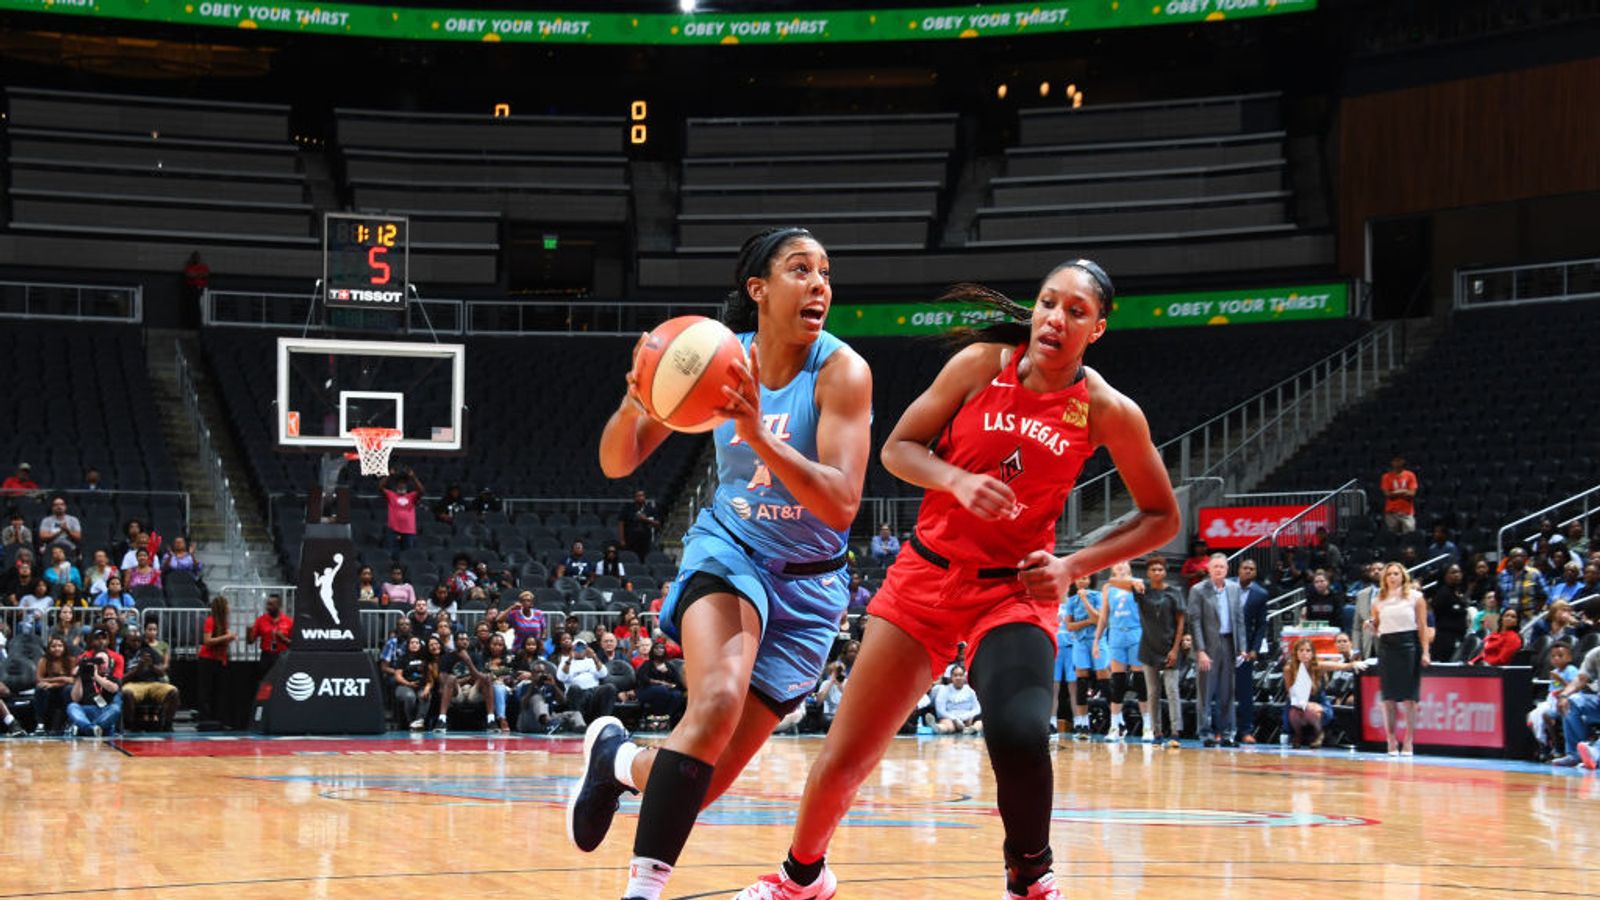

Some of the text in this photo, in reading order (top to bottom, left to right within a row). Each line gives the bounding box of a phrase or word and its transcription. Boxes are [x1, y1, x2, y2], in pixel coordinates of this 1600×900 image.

[200, 3, 349, 26] OBEY YOUR THIRST
[1165, 0, 1207, 15] OBEY
[445, 18, 591, 35] OBEY YOUR THIRST
[684, 19, 829, 37] OBEY YOUR THIRST
[922, 8, 1069, 31] OBEY YOUR THIRST
[357, 223, 398, 247] 1:12
[368, 246, 391, 285] 5
[1167, 294, 1330, 317] OBEY YOUR THIRST
[911, 311, 955, 326] OBEY
[984, 412, 1070, 457] LAS VEGAS
[756, 502, 804, 521] AT&T
[301, 629, 355, 640] WNBA
[317, 678, 371, 697] AT&T
